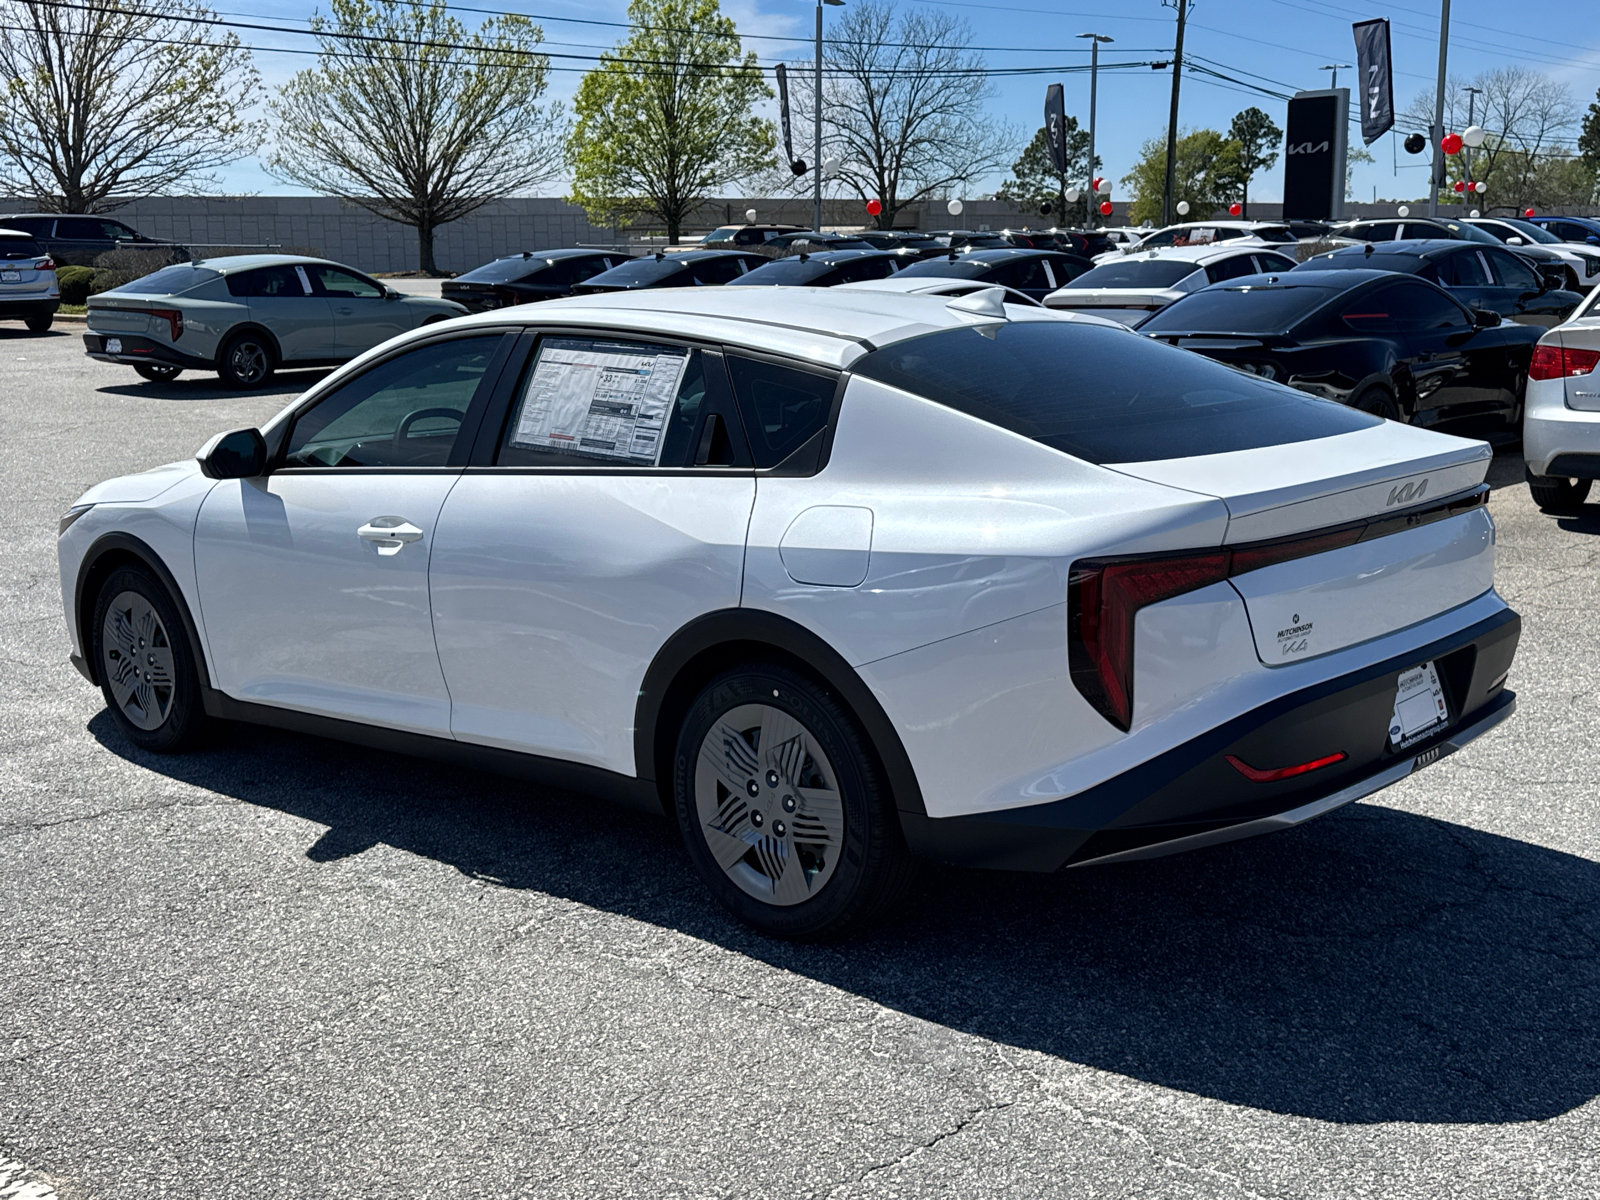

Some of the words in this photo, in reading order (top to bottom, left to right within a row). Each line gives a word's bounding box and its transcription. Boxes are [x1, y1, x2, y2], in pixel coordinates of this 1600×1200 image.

[1288, 141, 1329, 155] KIA
[603, 374, 613, 383] 33
[1386, 478, 1429, 506] KIA
[1277, 622, 1313, 638] HUTCHINSON
[1282, 638, 1308, 656] K4
[779, 689, 832, 743] SOLUS
[677, 754, 692, 833] KUMHO
